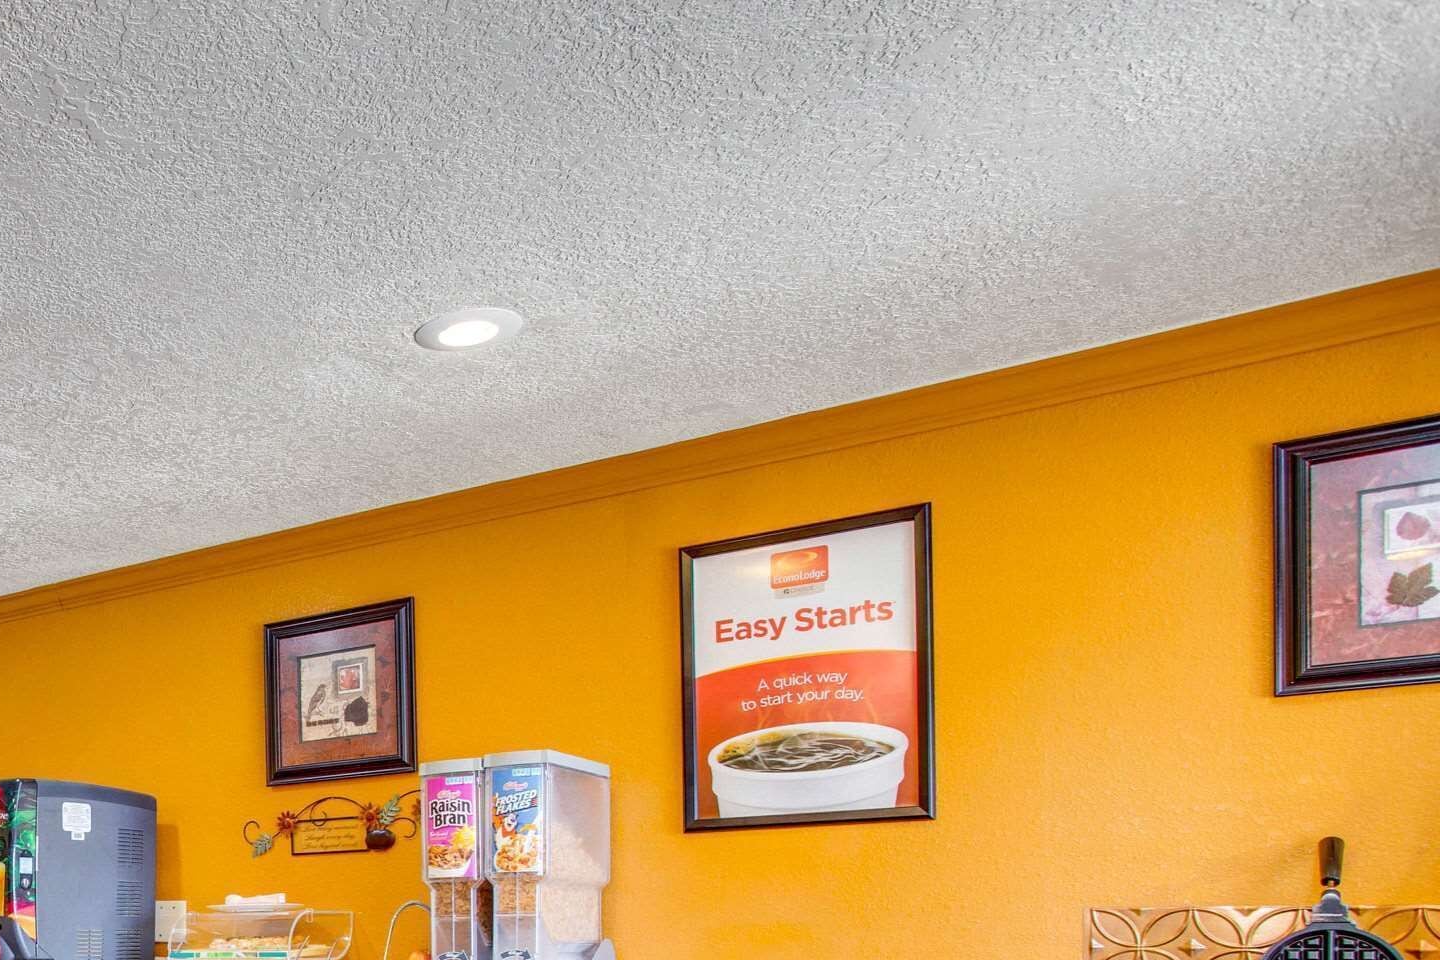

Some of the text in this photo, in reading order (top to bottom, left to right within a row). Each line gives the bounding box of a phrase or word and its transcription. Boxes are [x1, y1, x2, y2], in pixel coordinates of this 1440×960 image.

[714, 599, 894, 644] Easy Starts
[757, 672, 848, 692] A quick way
[741, 686, 864, 712] to start your day.
[430, 800, 471, 817] Raisin
[434, 813, 466, 828] Bran
